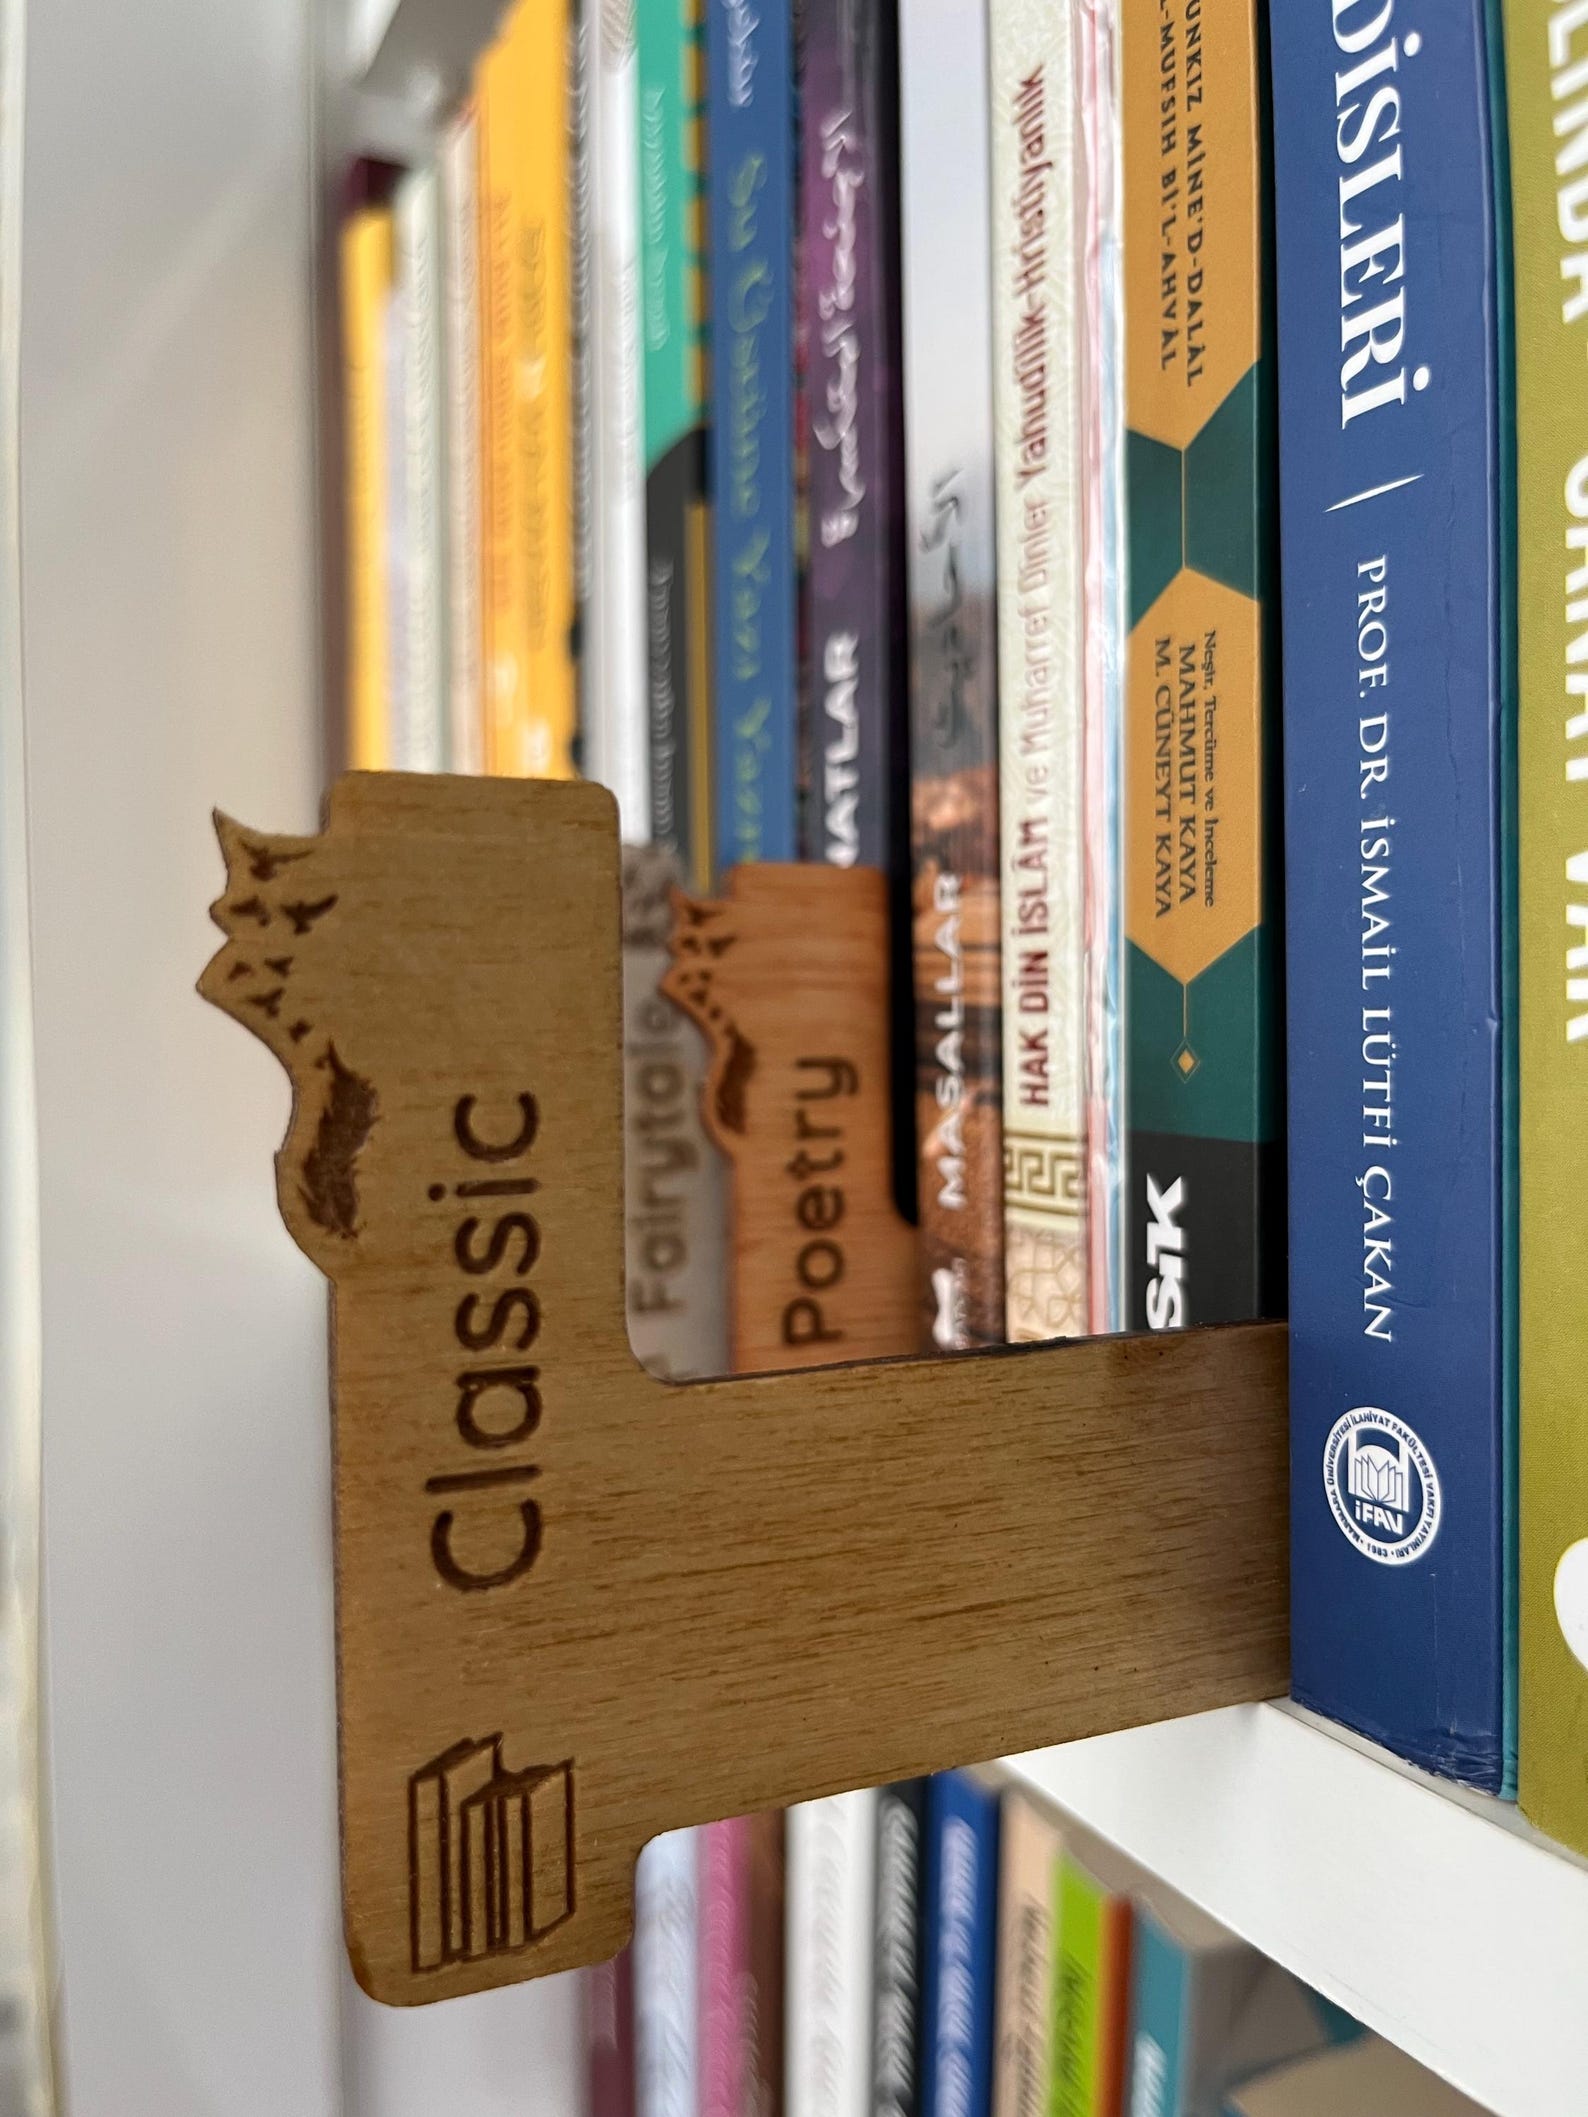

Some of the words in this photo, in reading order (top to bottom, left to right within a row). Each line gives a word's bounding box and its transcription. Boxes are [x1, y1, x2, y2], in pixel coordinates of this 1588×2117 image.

[1155, 638, 1172, 677] M.
[1357, 555, 1389, 699] PROF.
[1155, 685, 1175, 823] CÜNEYT
[1179, 644, 1196, 804] MAHMUT
[1203, 697, 1218, 781] Tercüme
[1358, 712, 1390, 800] DR.
[1179, 816, 1196, 904] KAYA
[1204, 788, 1215, 811] ve
[1155, 834, 1172, 919] KAYA
[1360, 816, 1397, 991] İSMAİL
[934, 873, 968, 1211] MASALLAR
[1011, 951, 1049, 1015] DİN
[1018, 1029, 1049, 1107] HAK
[1361, 1006, 1399, 1148] LÜTFİ
[781, 1056, 859, 1348] Poetry
[1354, 1165, 1395, 1343] ÇAKAN
[431, 1091, 544, 1593] Classic
